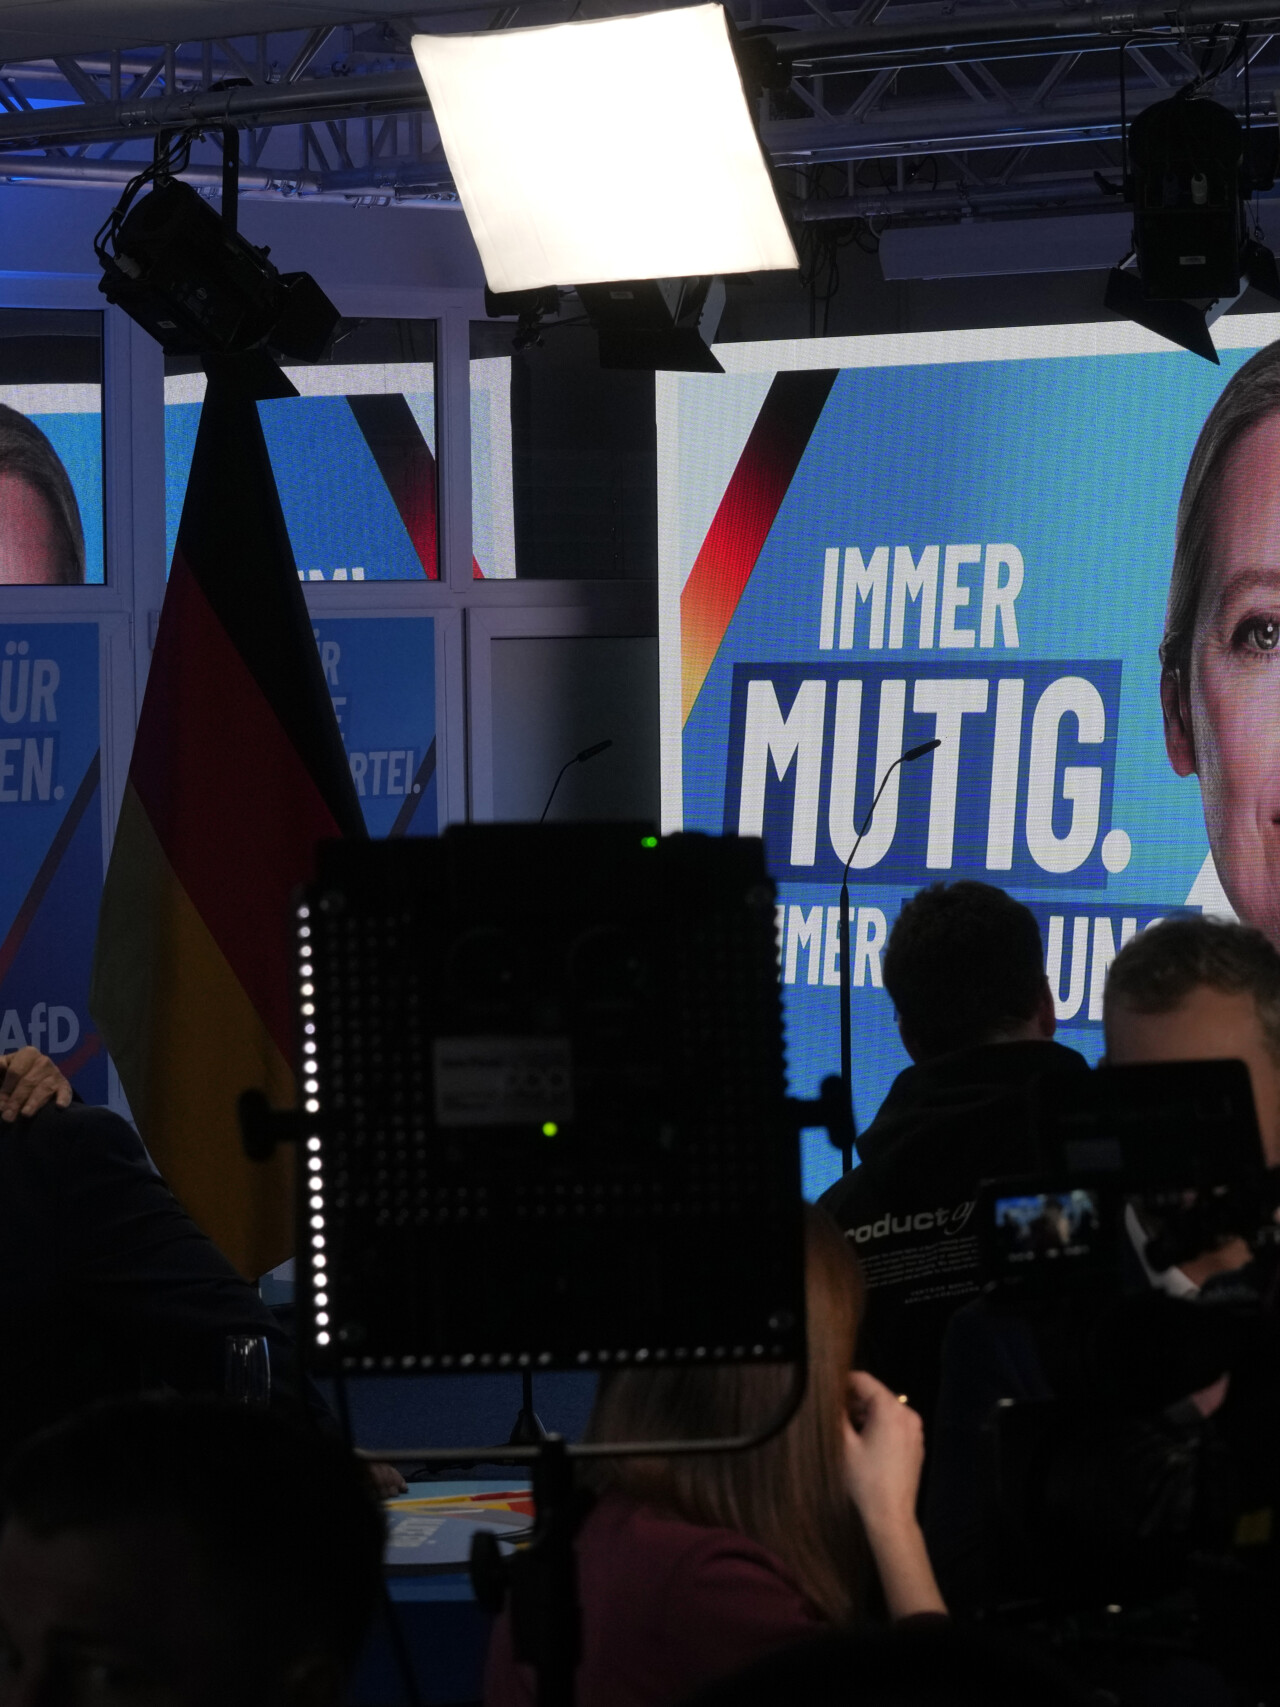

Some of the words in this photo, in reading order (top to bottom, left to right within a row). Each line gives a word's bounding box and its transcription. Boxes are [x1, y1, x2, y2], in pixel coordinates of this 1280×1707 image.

[819, 543, 1025, 650] IMMER
[737, 676, 1132, 875] MUTIG.
[0, 1002, 80, 1056] AfD
